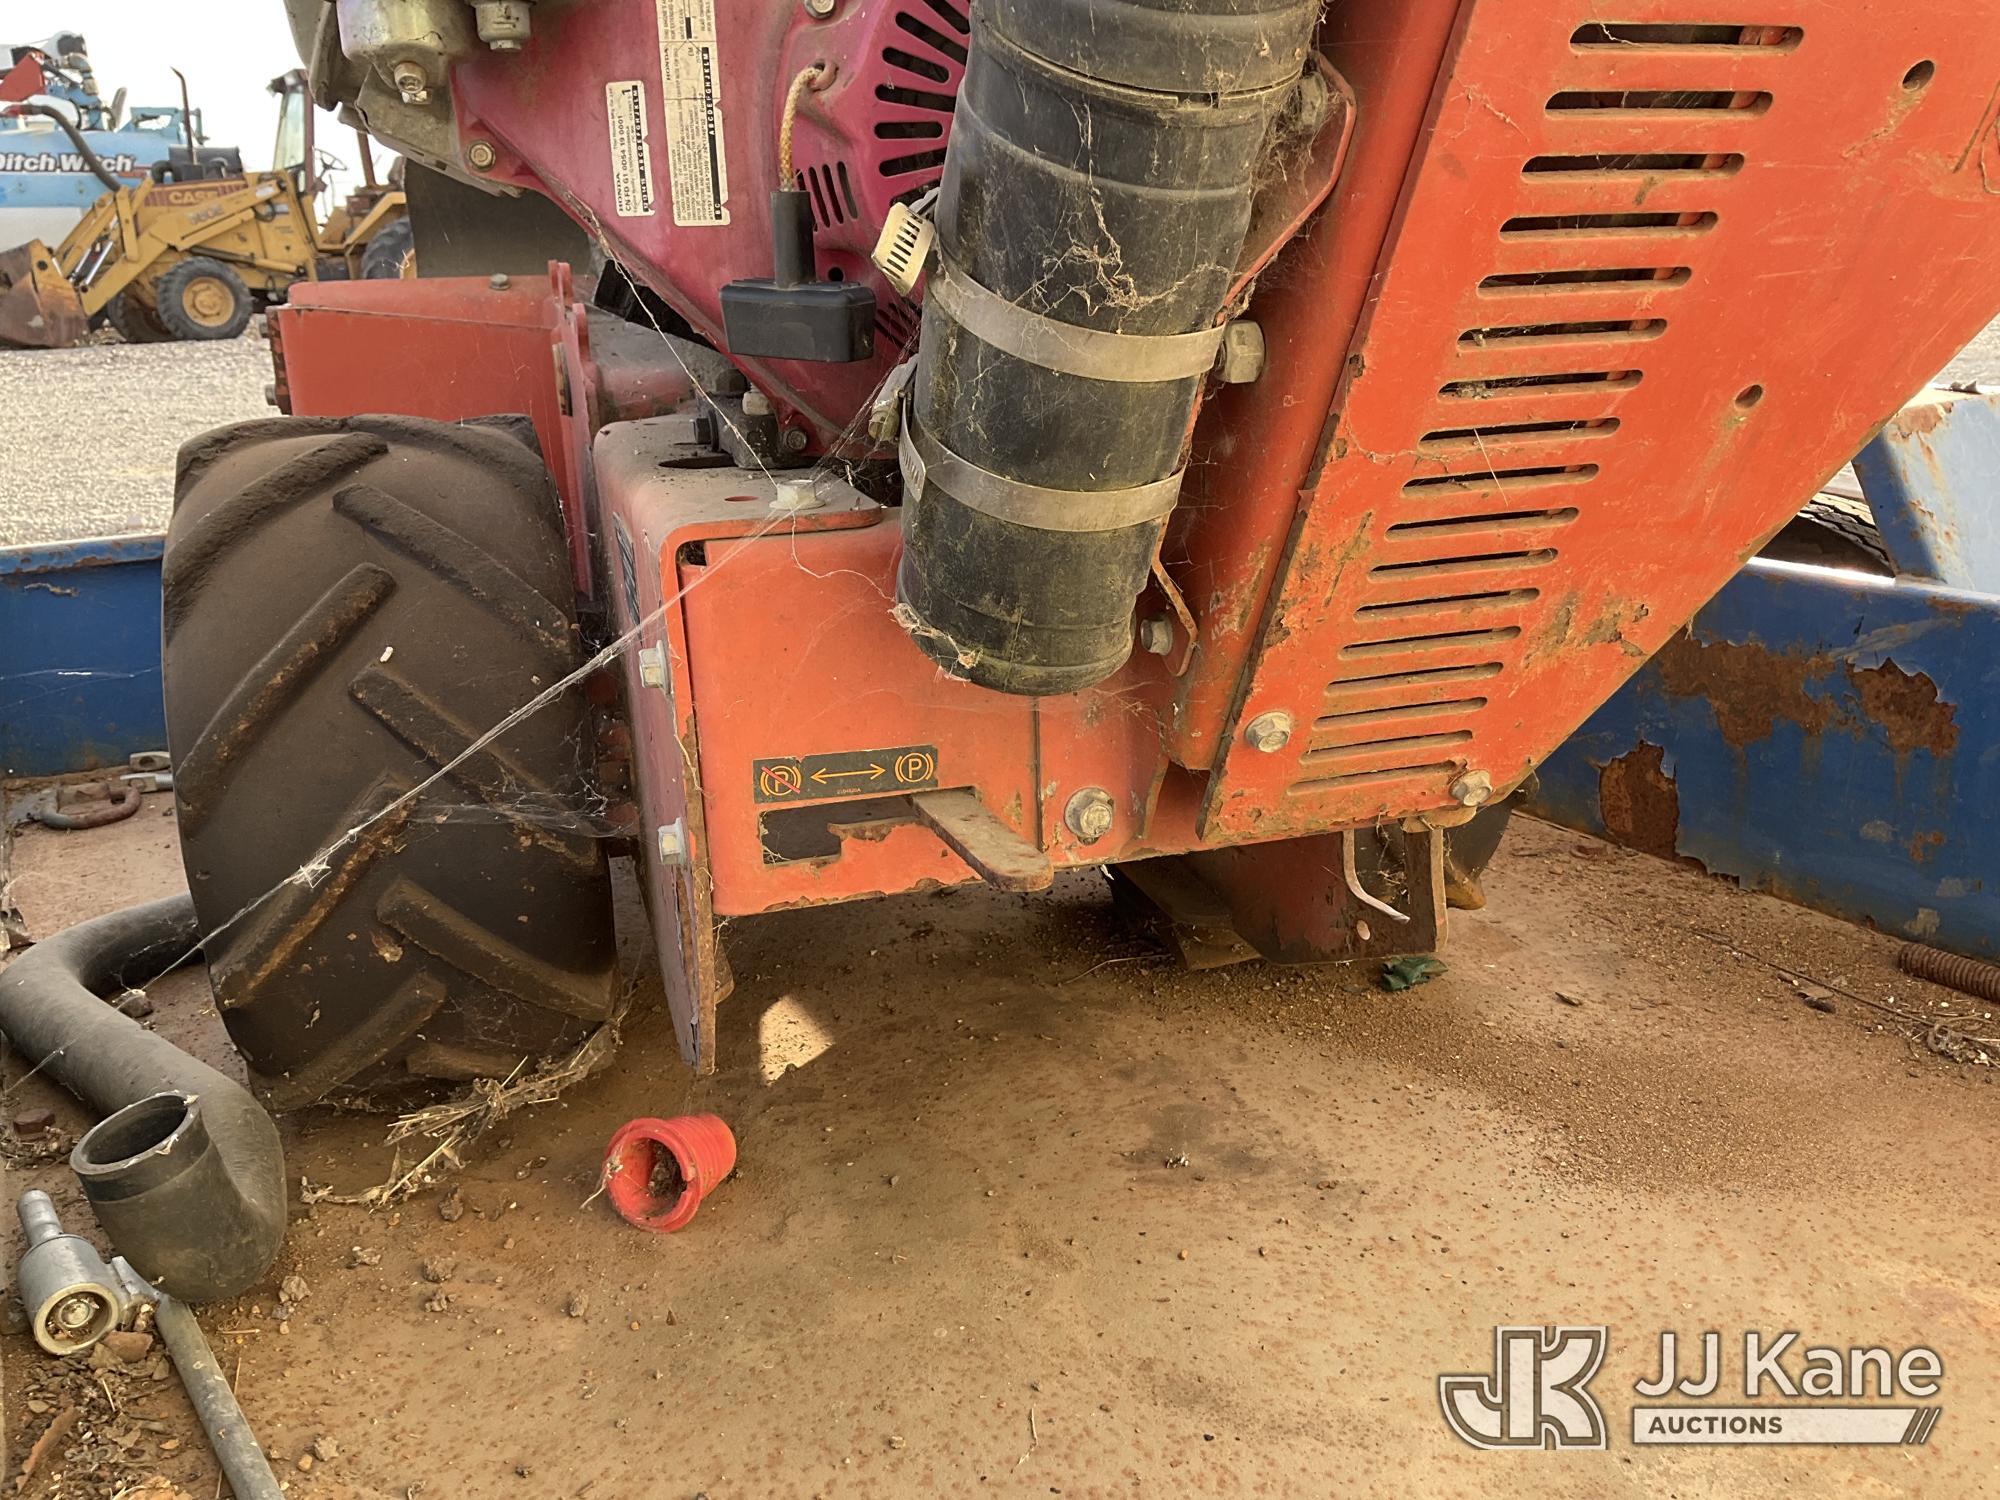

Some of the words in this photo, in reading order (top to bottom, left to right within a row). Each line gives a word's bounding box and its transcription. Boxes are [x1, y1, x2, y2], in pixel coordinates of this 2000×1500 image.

[663, 47, 671, 80] HONDA
[621, 88, 631, 96] 1
[59, 152, 133, 172] Wch
[615, 172, 623, 212] HONDA
[623, 185, 630, 197] FD
[624, 199, 631, 211] CN
